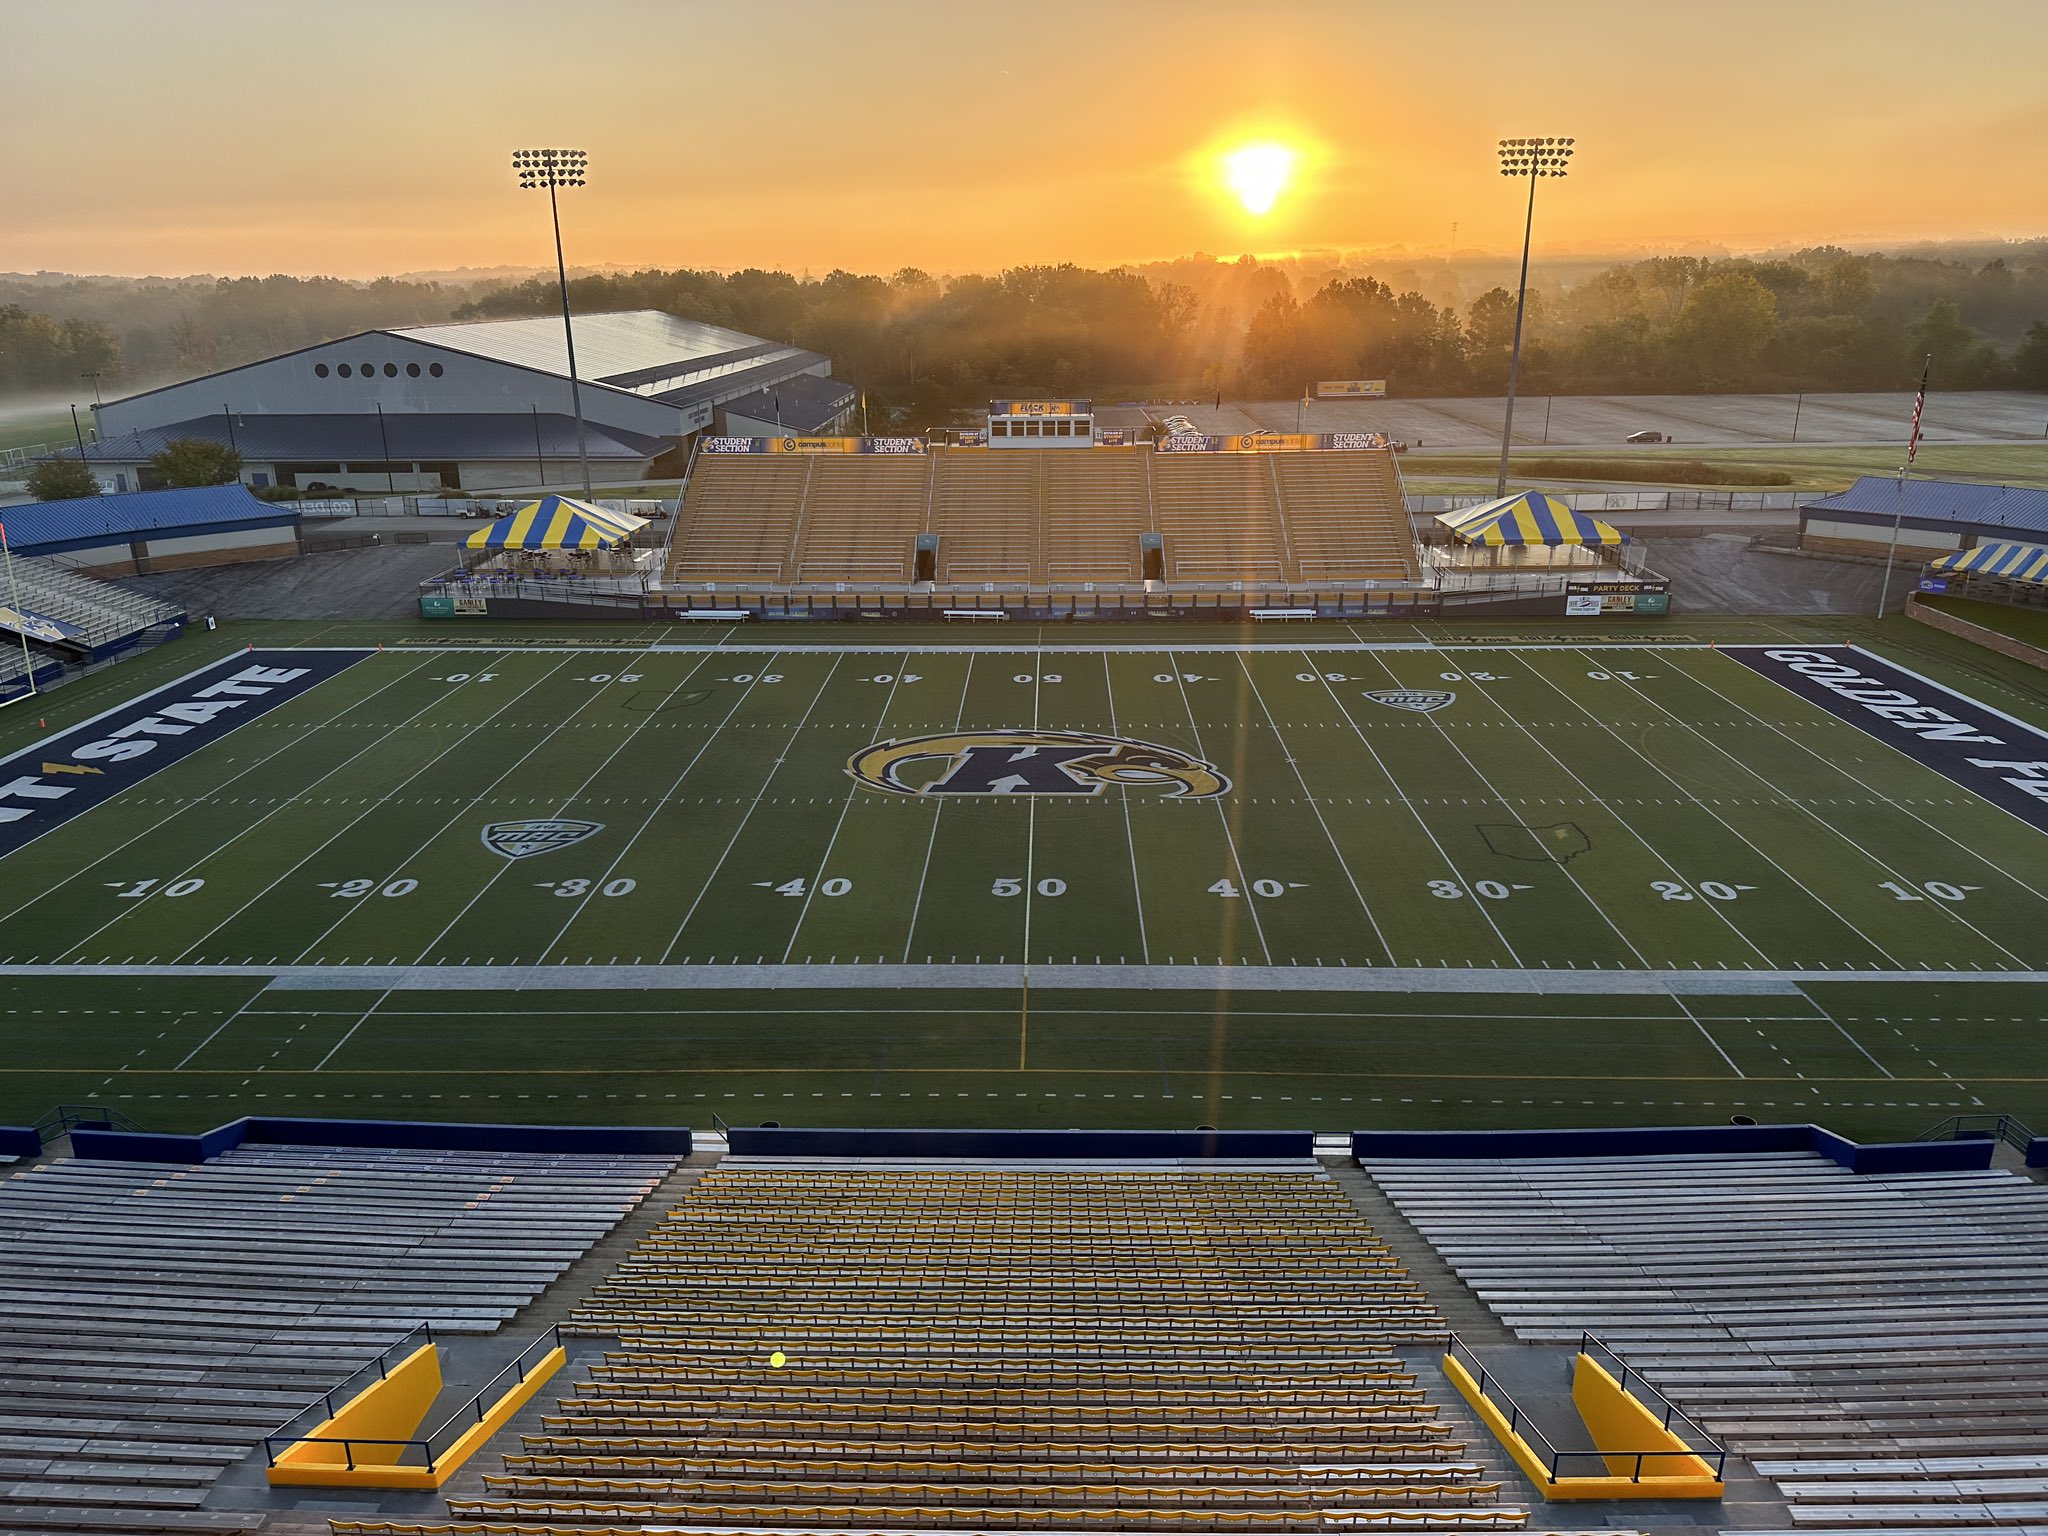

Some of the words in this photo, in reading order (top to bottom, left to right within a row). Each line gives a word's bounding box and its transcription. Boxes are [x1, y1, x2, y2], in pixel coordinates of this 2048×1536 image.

[713, 437, 752, 445] STUDENT
[874, 438, 912, 446] STUDENT
[1172, 436, 1210, 444] STUDENT
[1333, 433, 1373, 442] STUDENT
[715, 444, 750, 452] SECTION
[874, 445, 909, 453] SECTION
[1171, 443, 1206, 451] SECTION
[1333, 440, 1369, 449] SECTION
[1593, 584, 1619, 592] PARTY
[1620, 584, 1640, 592] DECK
[446, 673, 500, 683] 10
[589, 673, 644, 683] 20
[732, 673, 784, 684] 30
[873, 673, 923, 684] 40
[1012, 673, 1063, 684] 50
[1153, 673, 1204, 683] 40
[1295, 673, 1347, 683] 30
[1439, 671, 1496, 681] 20
[1587, 671, 1641, 681] 10
[1763, 650, 2007, 745] GOLDEN
[71, 664, 312, 762] STATE
[920, 745, 1121, 795] K
[488, 831, 582, 841] MAC
[117, 878, 205, 898] 10
[331, 878, 419, 898] 20
[553, 878, 637, 898] 30
[775, 877, 853, 897] 40
[991, 877, 1067, 897] 50
[1207, 878, 1285, 898] 40
[1426, 879, 1510, 900] 30
[1650, 880, 1739, 901] 20
[1878, 880, 1967, 901] 10
